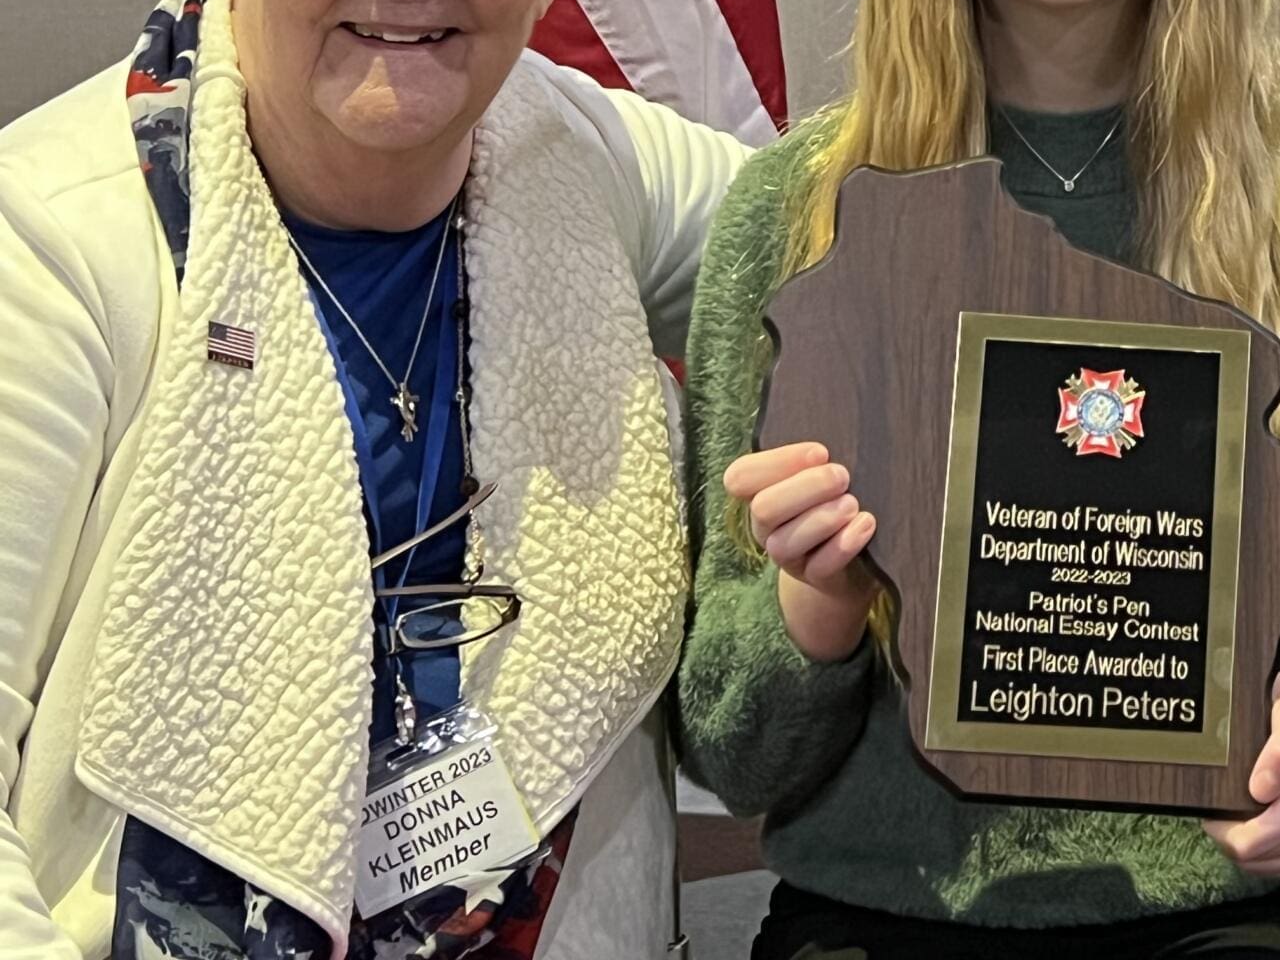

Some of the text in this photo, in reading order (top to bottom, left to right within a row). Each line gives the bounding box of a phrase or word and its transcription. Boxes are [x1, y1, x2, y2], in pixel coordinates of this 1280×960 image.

[986, 500, 1204, 539] Veteran of Foreign Wars
[980, 533, 1204, 570] Department of Wisconsin
[1051, 567, 1131, 585] 2022-2023
[1028, 591, 1151, 617] Patriot's Pen
[975, 610, 1199, 642] National Essay Contest
[982, 644, 1189, 680] First Place Awarded to
[970, 680, 1196, 722] Leighton Peters
[448, 747, 492, 779] 2023
[384, 789, 466, 841] DONNA
[368, 800, 499, 878] KLEINMAUS
[399, 832, 491, 894] Member
